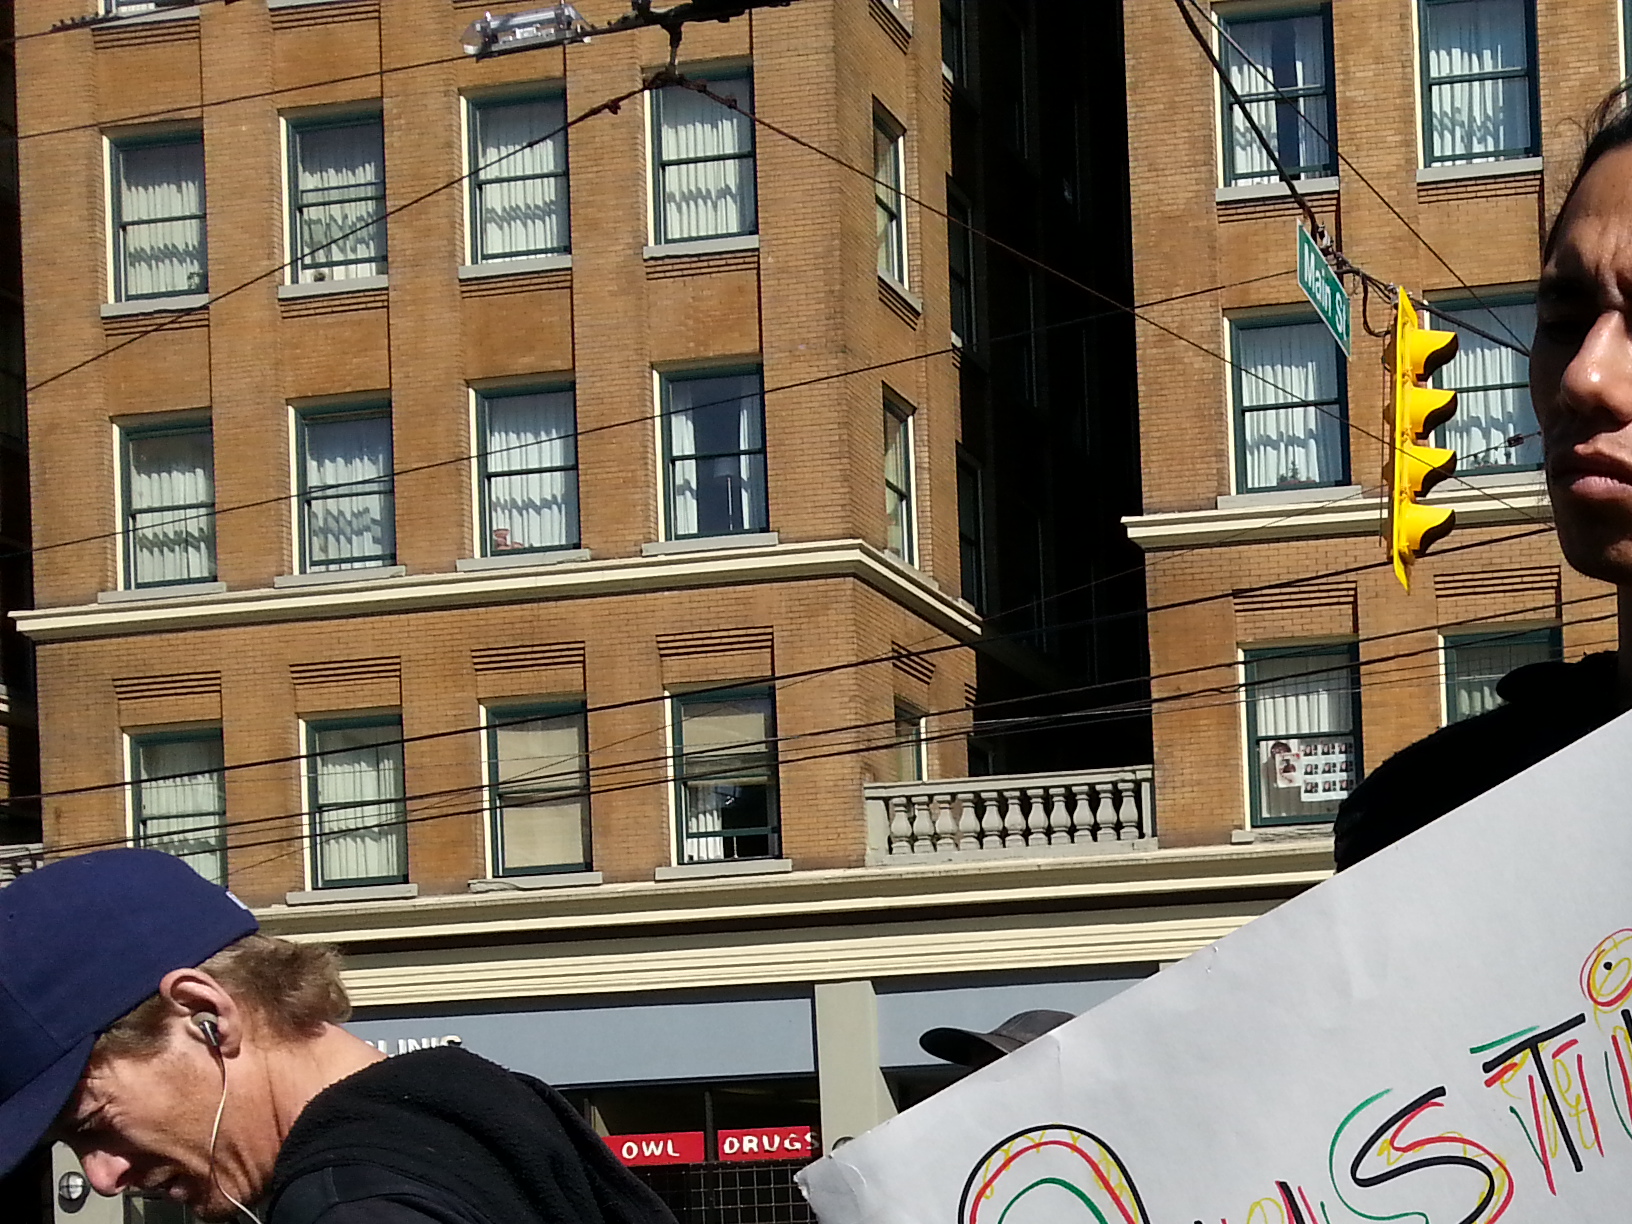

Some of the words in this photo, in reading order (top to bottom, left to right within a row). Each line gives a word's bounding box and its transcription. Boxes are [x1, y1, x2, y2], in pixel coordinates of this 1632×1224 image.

[1304, 242, 1332, 317] Main
[1335, 291, 1347, 341] St
[621, 1138, 680, 1160] OWL
[723, 1131, 820, 1155] DRUGS
